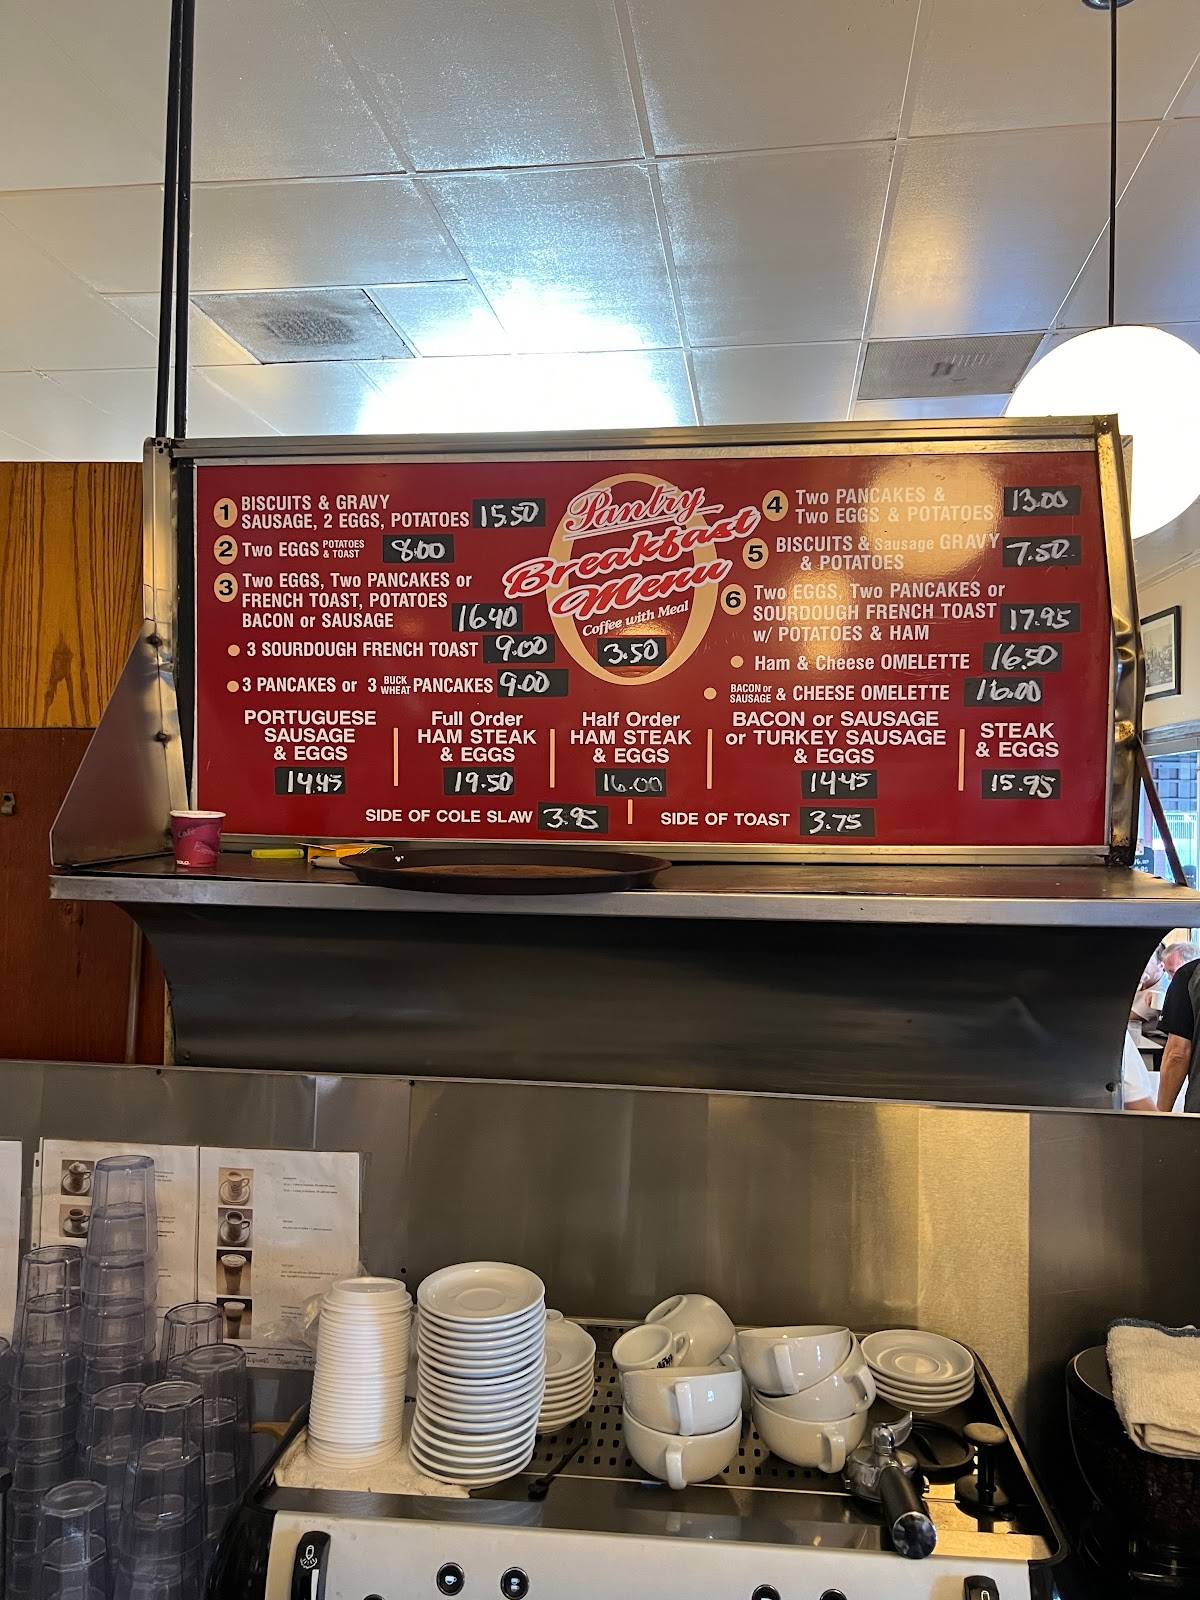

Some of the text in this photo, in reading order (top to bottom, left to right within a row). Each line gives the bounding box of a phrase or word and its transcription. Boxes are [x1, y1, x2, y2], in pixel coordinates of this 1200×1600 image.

[241, 494, 390, 511] BISCUITS & GRAVY
[795, 486, 945, 505] Two PANCAKES &
[219, 504, 229, 521] 1
[563, 485, 724, 540] Pantry
[766, 496, 783, 514] 4
[241, 512, 470, 531] SAUSAGE, 2 EGGS, POTATOES
[481, 501, 540, 528] 15.50
[795, 504, 994, 525] Two EGGS & POTATOES
[218, 540, 233, 557] 2
[242, 541, 319, 557] Two EGGS
[322, 539, 365, 549] POTATOES
[776, 533, 1001, 553] BISCUITS & Sausage GRAVY
[322, 550, 360, 559] & TOAST
[502, 505, 761, 599] Breakfast
[747, 545, 763, 562] 5
[800, 554, 905, 571] & POTATOES
[218, 579, 234, 596] 3
[242, 572, 472, 590] Two EGGS, Two PANCAKES or
[549, 557, 734, 621] Menu
[725, 590, 741, 608] 6
[753, 581, 1006, 601] Two EGGS, Two PANCAKES or
[242, 592, 448, 610] FRENCH TOAST, POTATOES
[242, 612, 394, 628] BACON or SAUSAGE
[582, 600, 690, 637] Coffee with Meal
[752, 602, 997, 621] SOURDOUGH FRENCH TOAST
[1010, 606, 1072, 631] 17.95
[752, 624, 930, 643] w/ POTATOES & HAM
[246, 641, 479, 657] 3 SOURDOUGH FRENCH TOAST
[495, 635, 548, 662] 9.00
[603, 639, 659, 664] 3.50
[991, 643, 1059, 671] 16.50
[754, 653, 970, 671] Ham & Cheese OMELETTE
[242, 676, 378, 692] 3 PANCAKES or 3
[383, 675, 408, 685] BUCK
[413, 677, 494, 694] PANCAKES
[500, 671, 551, 697] 9.00
[730, 684, 772, 693] BACON or
[380, 685, 412, 695] WHEAT
[729, 694, 771, 703] SAUSAGE
[775, 685, 950, 701] & CHEESE OMELETTE
[244, 710, 377, 725] PORTUGUESE
[431, 711, 524, 726] Full Order
[582, 712, 681, 727] Half Order
[732, 711, 939, 727] BACON or SAUSAGE
[264, 728, 356, 743] SAUSAGE
[418, 729, 538, 745] HAM STEAK
[570, 730, 692, 745] HAM STEAK
[725, 730, 947, 746] or TURKEY SAUSAGE
[980, 723, 1055, 739] STEAK
[273, 746, 348, 761] & EGGS
[440, 747, 516, 762] & EGGS
[592, 748, 670, 763] & EGGS
[793, 749, 875, 764] & EGGS
[975, 742, 1059, 758] & EGGS
[454, 771, 514, 793] 19.50
[603, 773, 663, 793] 16.00
[991, 774, 1056, 798] 15.95
[365, 809, 533, 824] SIDE OF COLE SLAW
[660, 812, 790, 827] SIDE OF TOAST
[809, 810, 863, 835] 3.75
